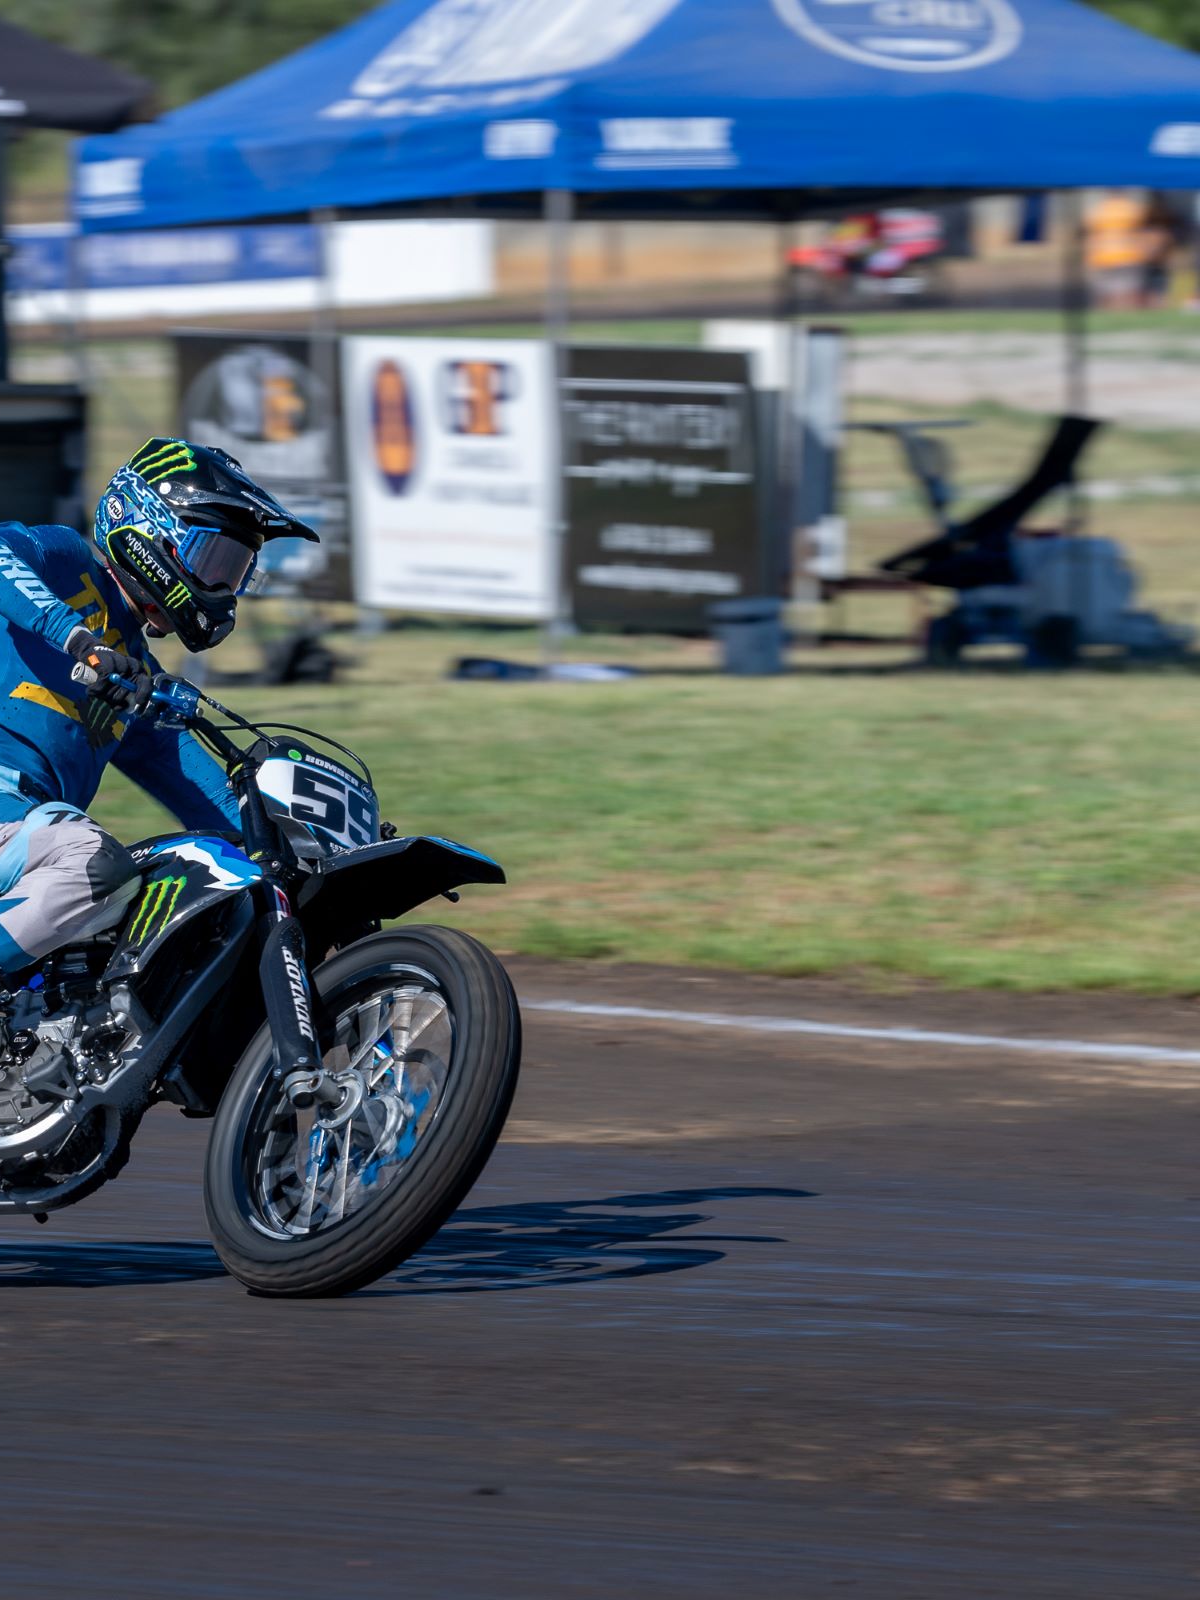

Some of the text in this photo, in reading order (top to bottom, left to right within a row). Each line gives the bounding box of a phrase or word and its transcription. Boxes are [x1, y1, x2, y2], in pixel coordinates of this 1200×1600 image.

[108, 496, 124, 518] Arai
[125, 532, 172, 586] MONSTER
[126, 548, 159, 583] ENERGY
[305, 754, 359, 786] BOMBER
[290, 764, 376, 848] 59
[282, 949, 314, 1042] DUNLOP
